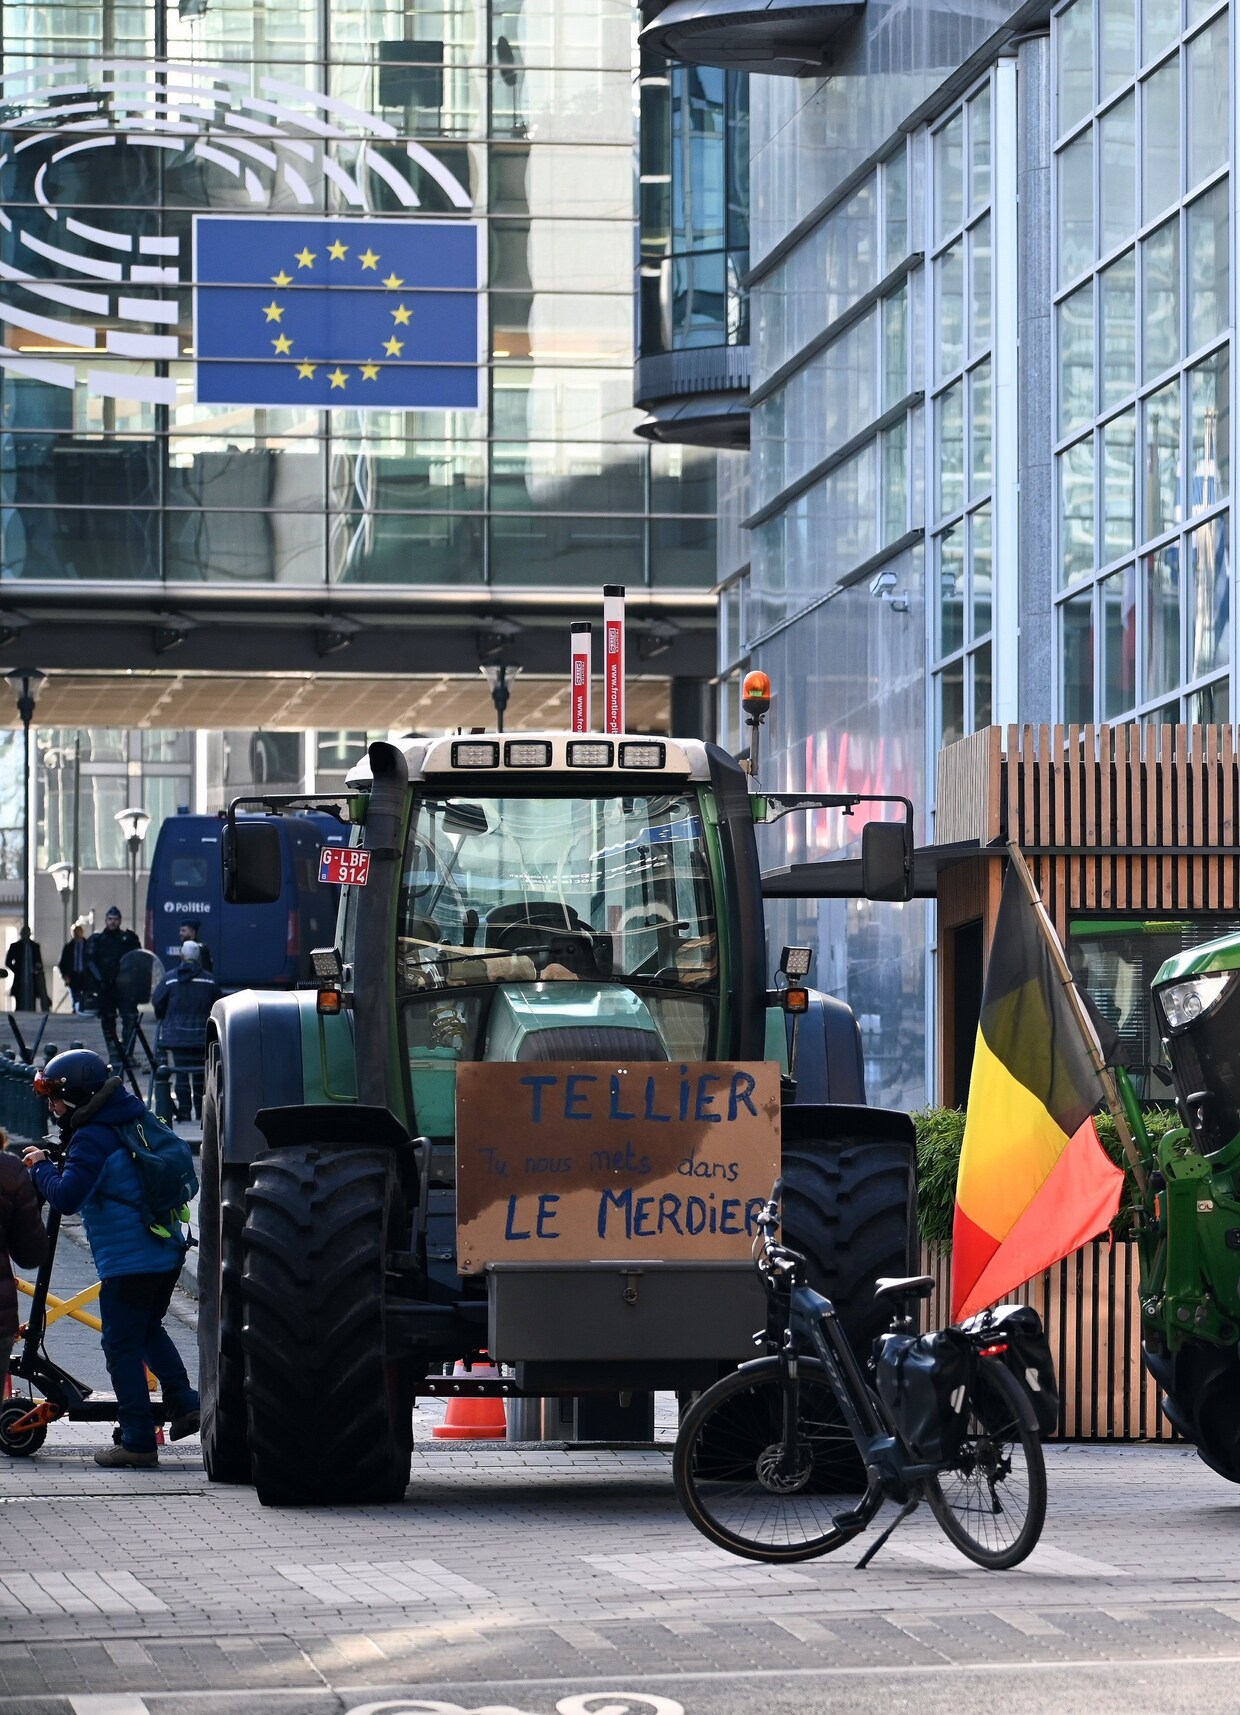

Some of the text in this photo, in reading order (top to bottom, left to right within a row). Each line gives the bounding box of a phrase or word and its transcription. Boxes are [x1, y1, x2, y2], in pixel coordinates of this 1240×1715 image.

[610, 664, 619, 735] www.frontier-pit
[322, 849, 368, 867] G-LBF
[338, 866, 366, 883] 914
[175, 902, 211, 913] Politie
[524, 1152, 572, 1175] nous
[589, 1140, 652, 1175] mets
[677, 1146, 738, 1182] dans
[505, 1193, 560, 1240] LE
